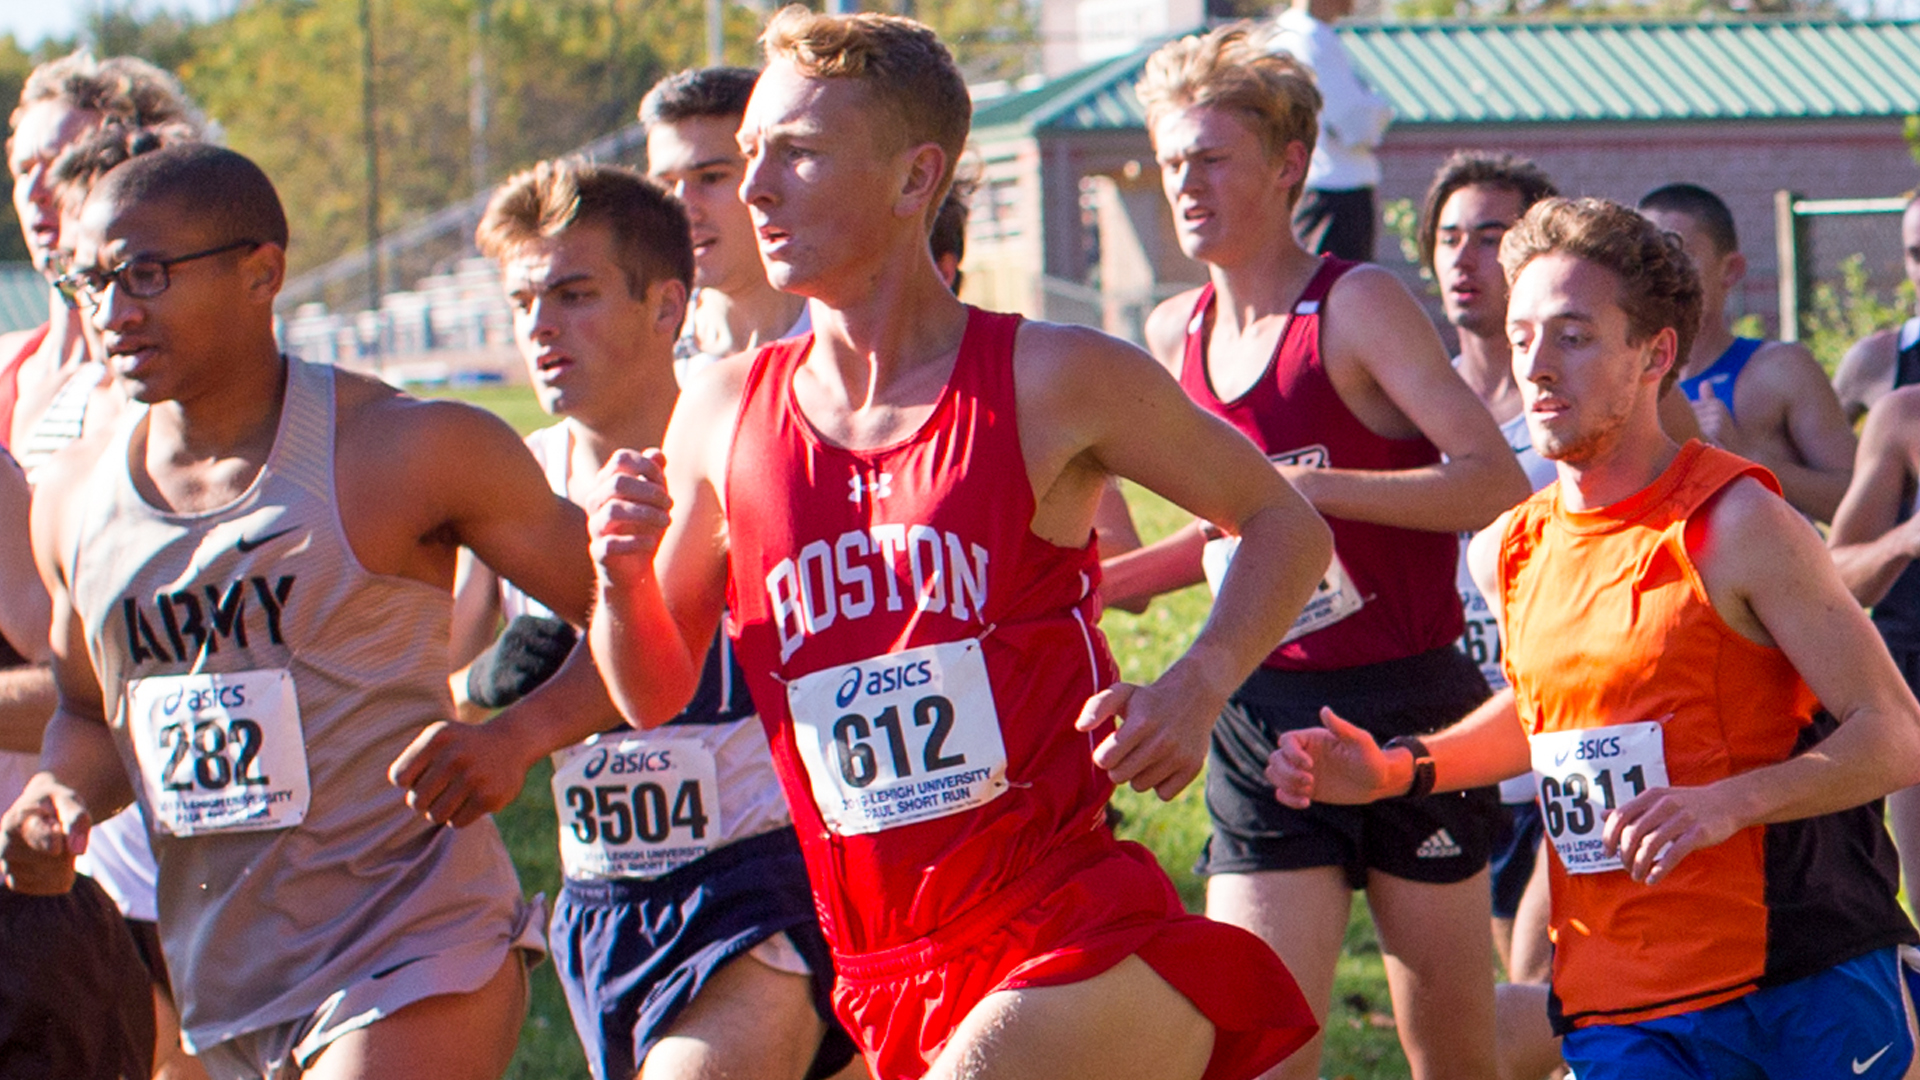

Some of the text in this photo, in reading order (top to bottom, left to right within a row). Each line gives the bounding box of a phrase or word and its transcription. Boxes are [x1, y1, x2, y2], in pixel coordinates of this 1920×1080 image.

[766, 523, 988, 665] BOSTON
[123, 574, 296, 664] ARMY
[867, 659, 932, 697] asics
[187, 684, 246, 711] asics
[160, 718, 269, 792] 282
[833, 694, 967, 789] 612
[1575, 736, 1621, 760] asics
[610, 751, 671, 774] asics
[864, 805, 896, 820] PAUL
[897, 793, 939, 813] SHORT
[942, 786, 972, 805] RUN
[870, 785, 915, 804] LEHIGH
[917, 767, 992, 794] UNIVERSITY
[1541, 764, 1647, 838] 6311
[565, 779, 709, 845] 3504
[1573, 839, 1603, 852] LEHIG
